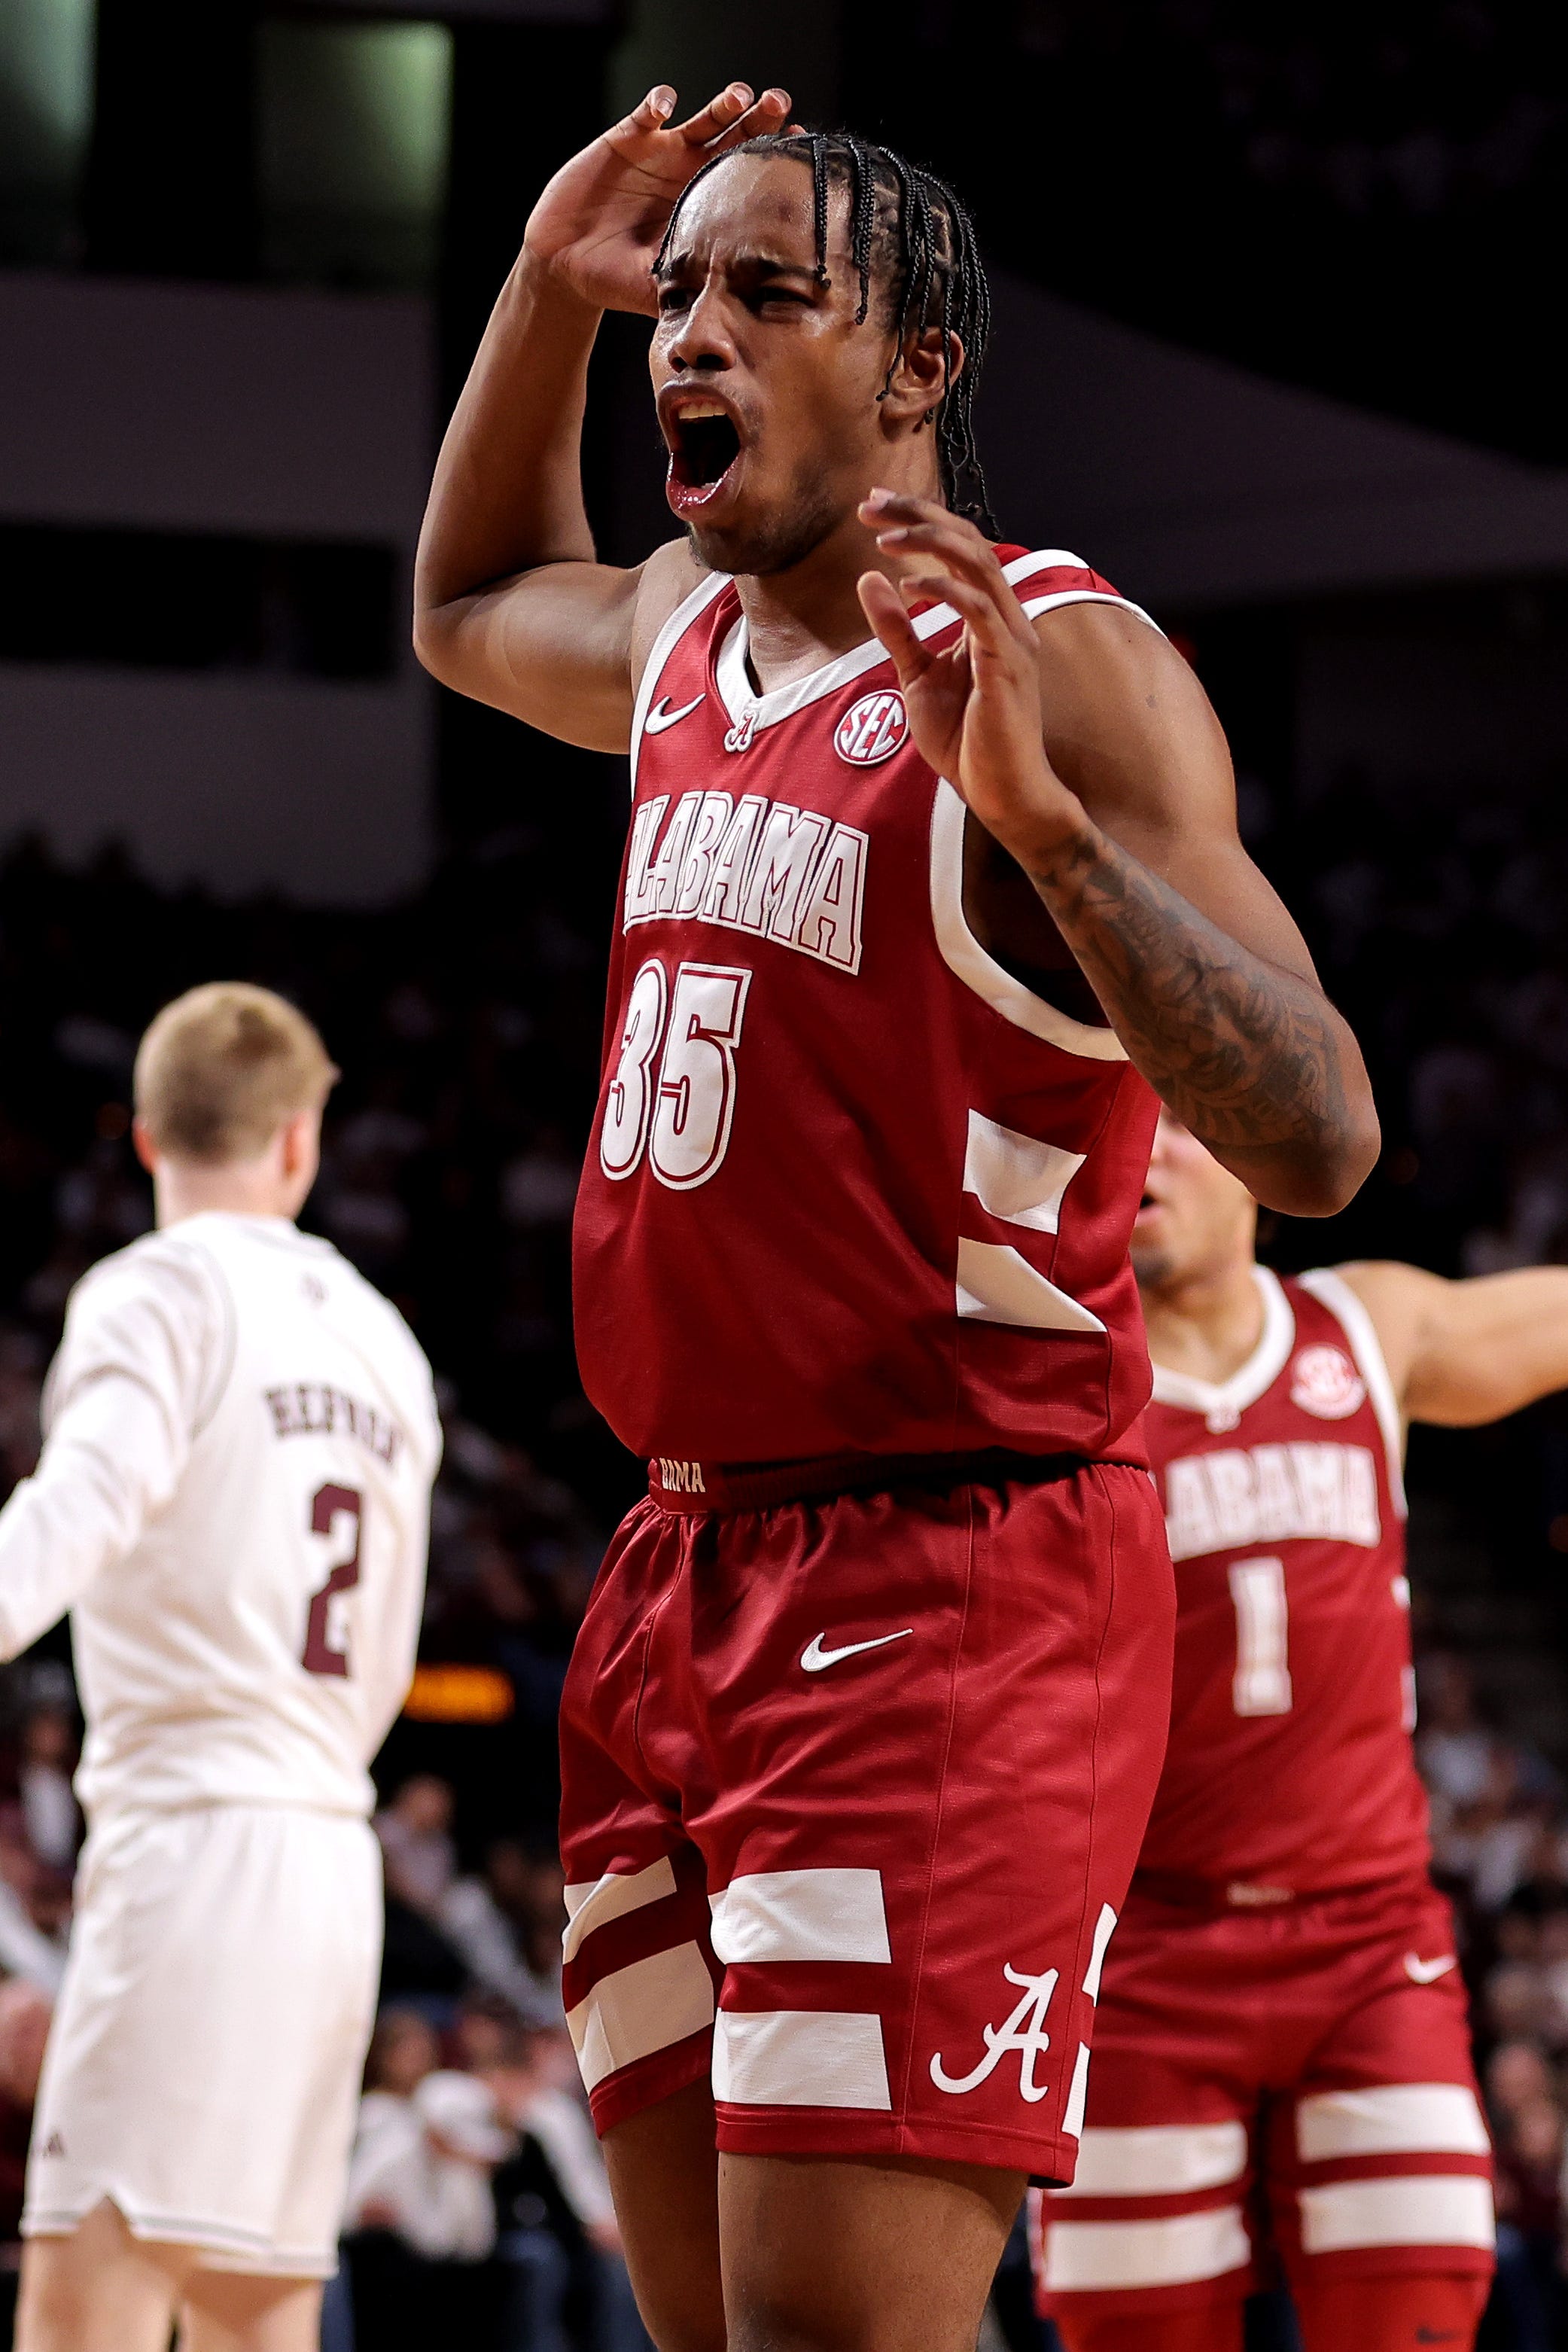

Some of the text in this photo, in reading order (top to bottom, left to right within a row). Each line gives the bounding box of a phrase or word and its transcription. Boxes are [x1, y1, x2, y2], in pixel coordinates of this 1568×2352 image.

[840, 694, 904, 760] SEC
[601, 958, 753, 1190] 35
[659, 1457, 706, 1493] BAMA
[1166, 1440, 1381, 1562] ABAMA
[302, 1483, 362, 1679] 2
[1227, 1555, 1292, 1717] 1
[930, 1962, 1059, 2103] A
